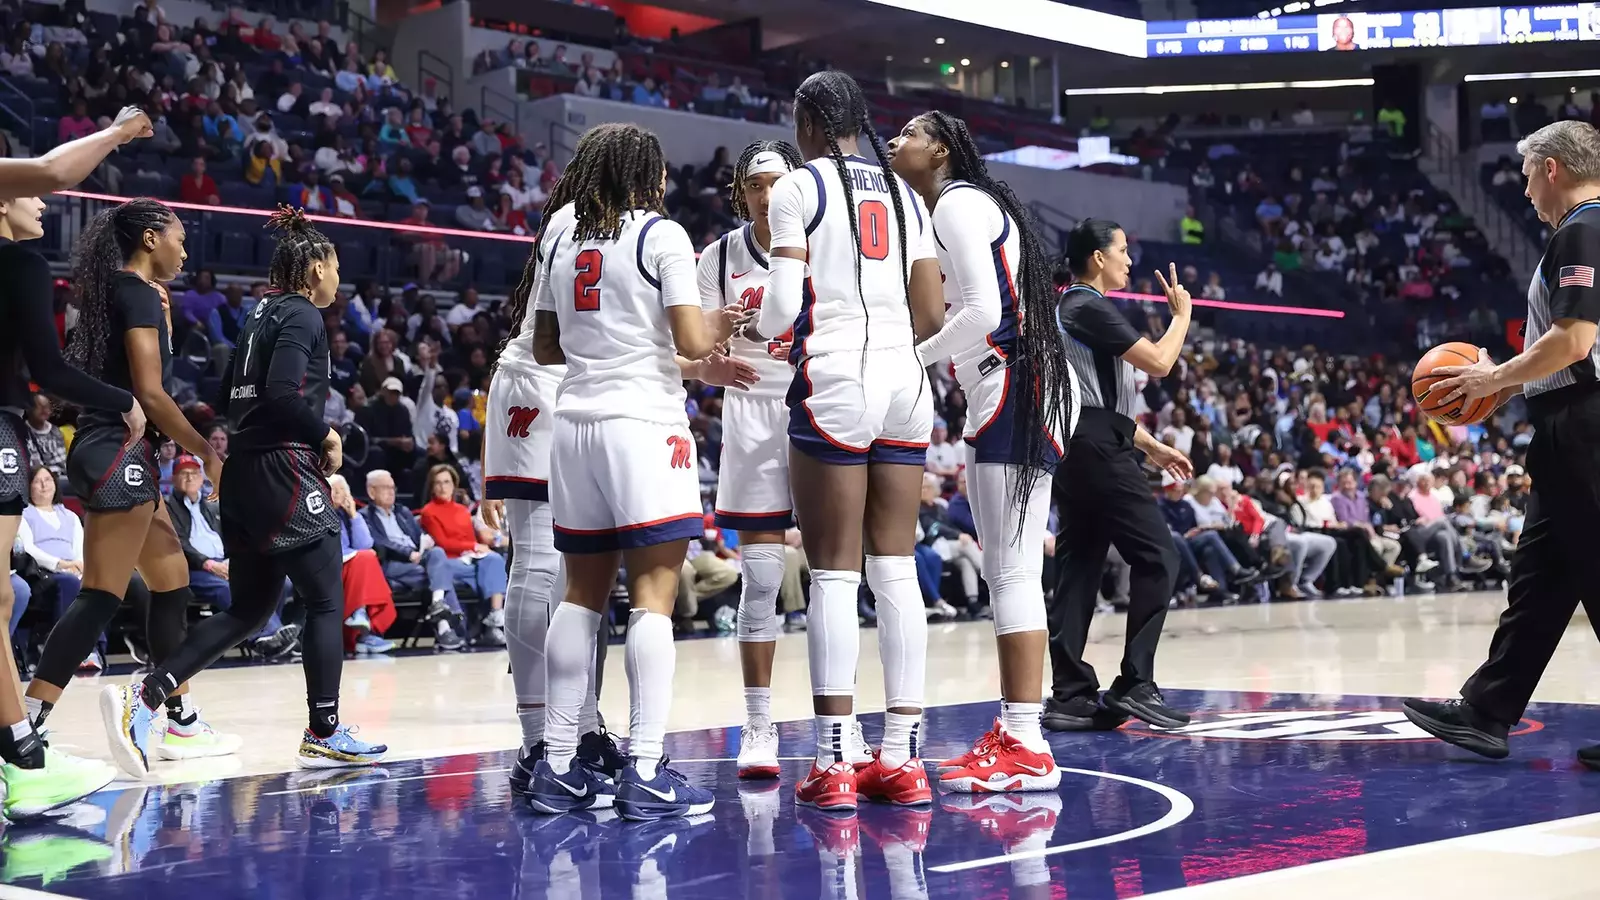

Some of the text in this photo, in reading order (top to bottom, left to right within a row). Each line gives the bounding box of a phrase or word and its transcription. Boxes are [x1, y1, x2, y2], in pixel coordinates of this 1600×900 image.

[846, 168, 891, 194] HIENO
[858, 200, 889, 261] 0
[574, 248, 604, 312] 2
[243, 332, 254, 376] 1
